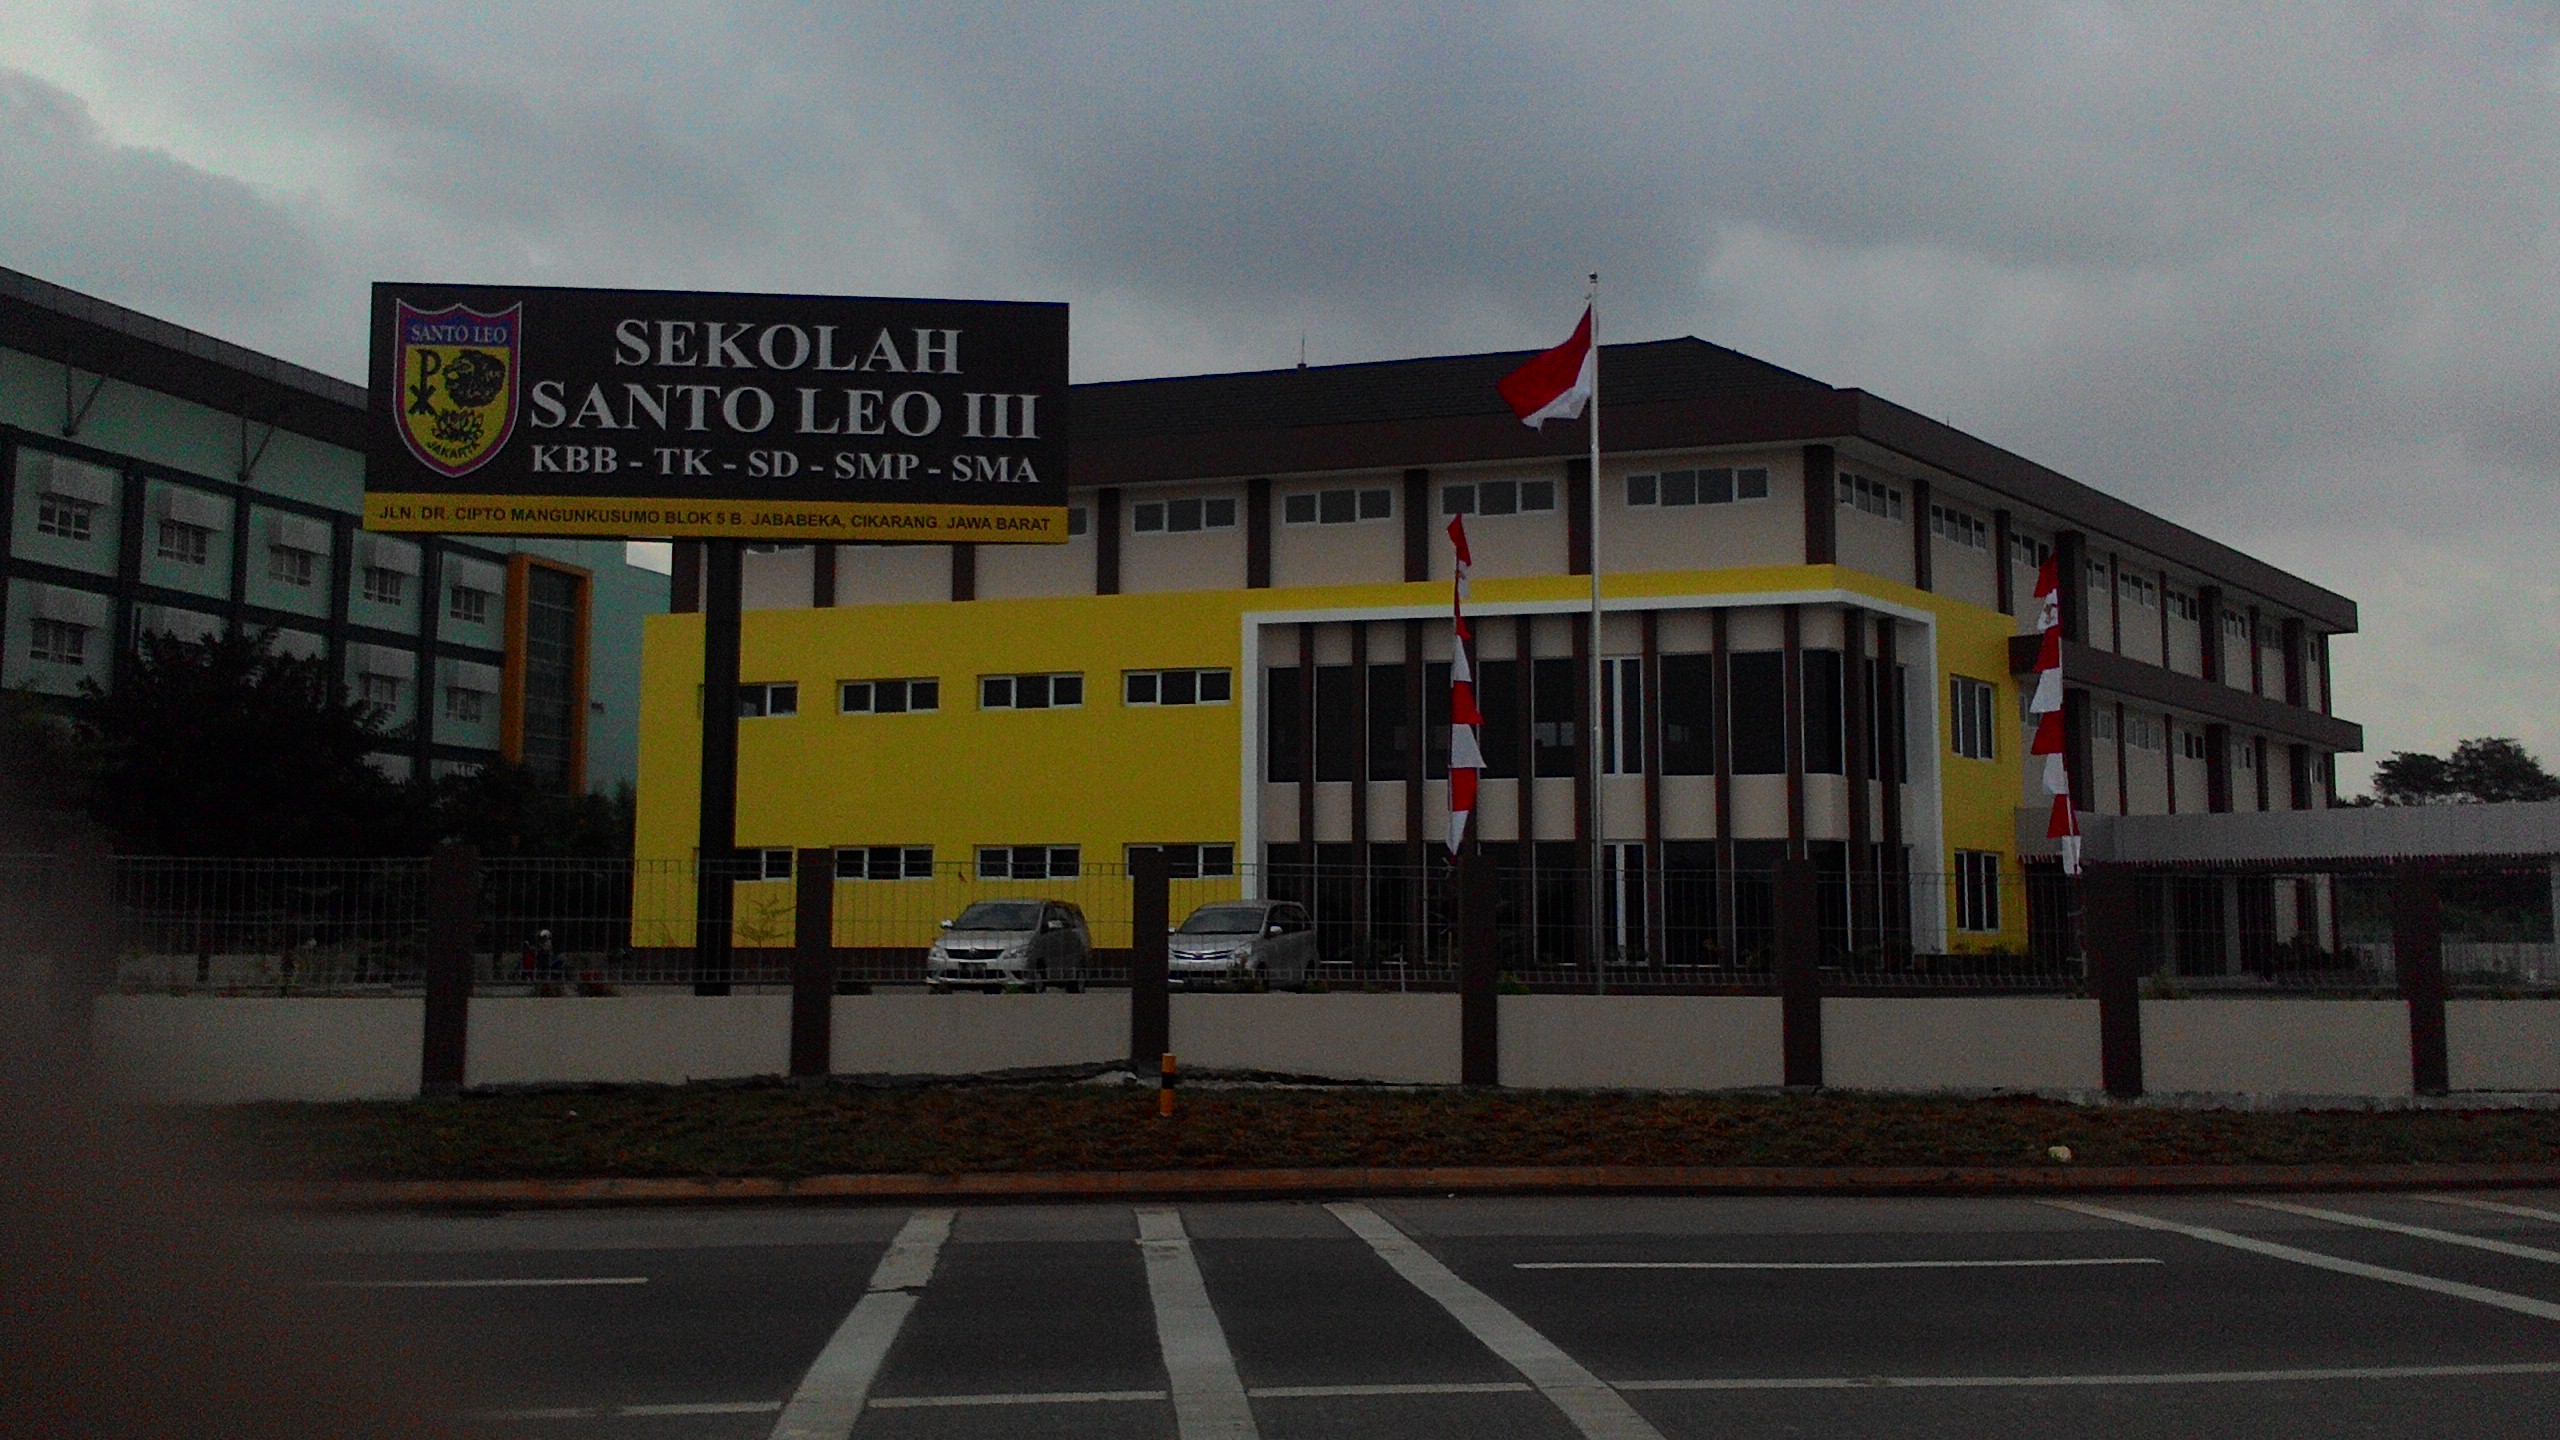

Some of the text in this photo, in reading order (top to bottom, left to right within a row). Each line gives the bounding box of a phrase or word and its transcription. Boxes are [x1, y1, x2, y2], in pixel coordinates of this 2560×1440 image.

[411, 324, 507, 344] SANTO LEO
[615, 319, 962, 374] SEKOLAH
[531, 380, 1040, 439] SANTO LEO III
[427, 441, 483, 459] JAKARTA
[532, 446, 618, 474] KBB
[654, 448, 711, 475] TK
[749, 450, 798, 477] SD
[834, 454, 920, 480] SMP
[952, 457, 1040, 483] SMA
[455, 508, 506, 521] CIPTO
[511, 509, 660, 525] MANGUNKUSUMO
[665, 511, 711, 525] BLOK
[716, 512, 726, 525] 5
[751, 513, 846, 529] JABABEKA,
[947, 516, 992, 530] JAWA
[997, 517, 1051, 531] BARAT
